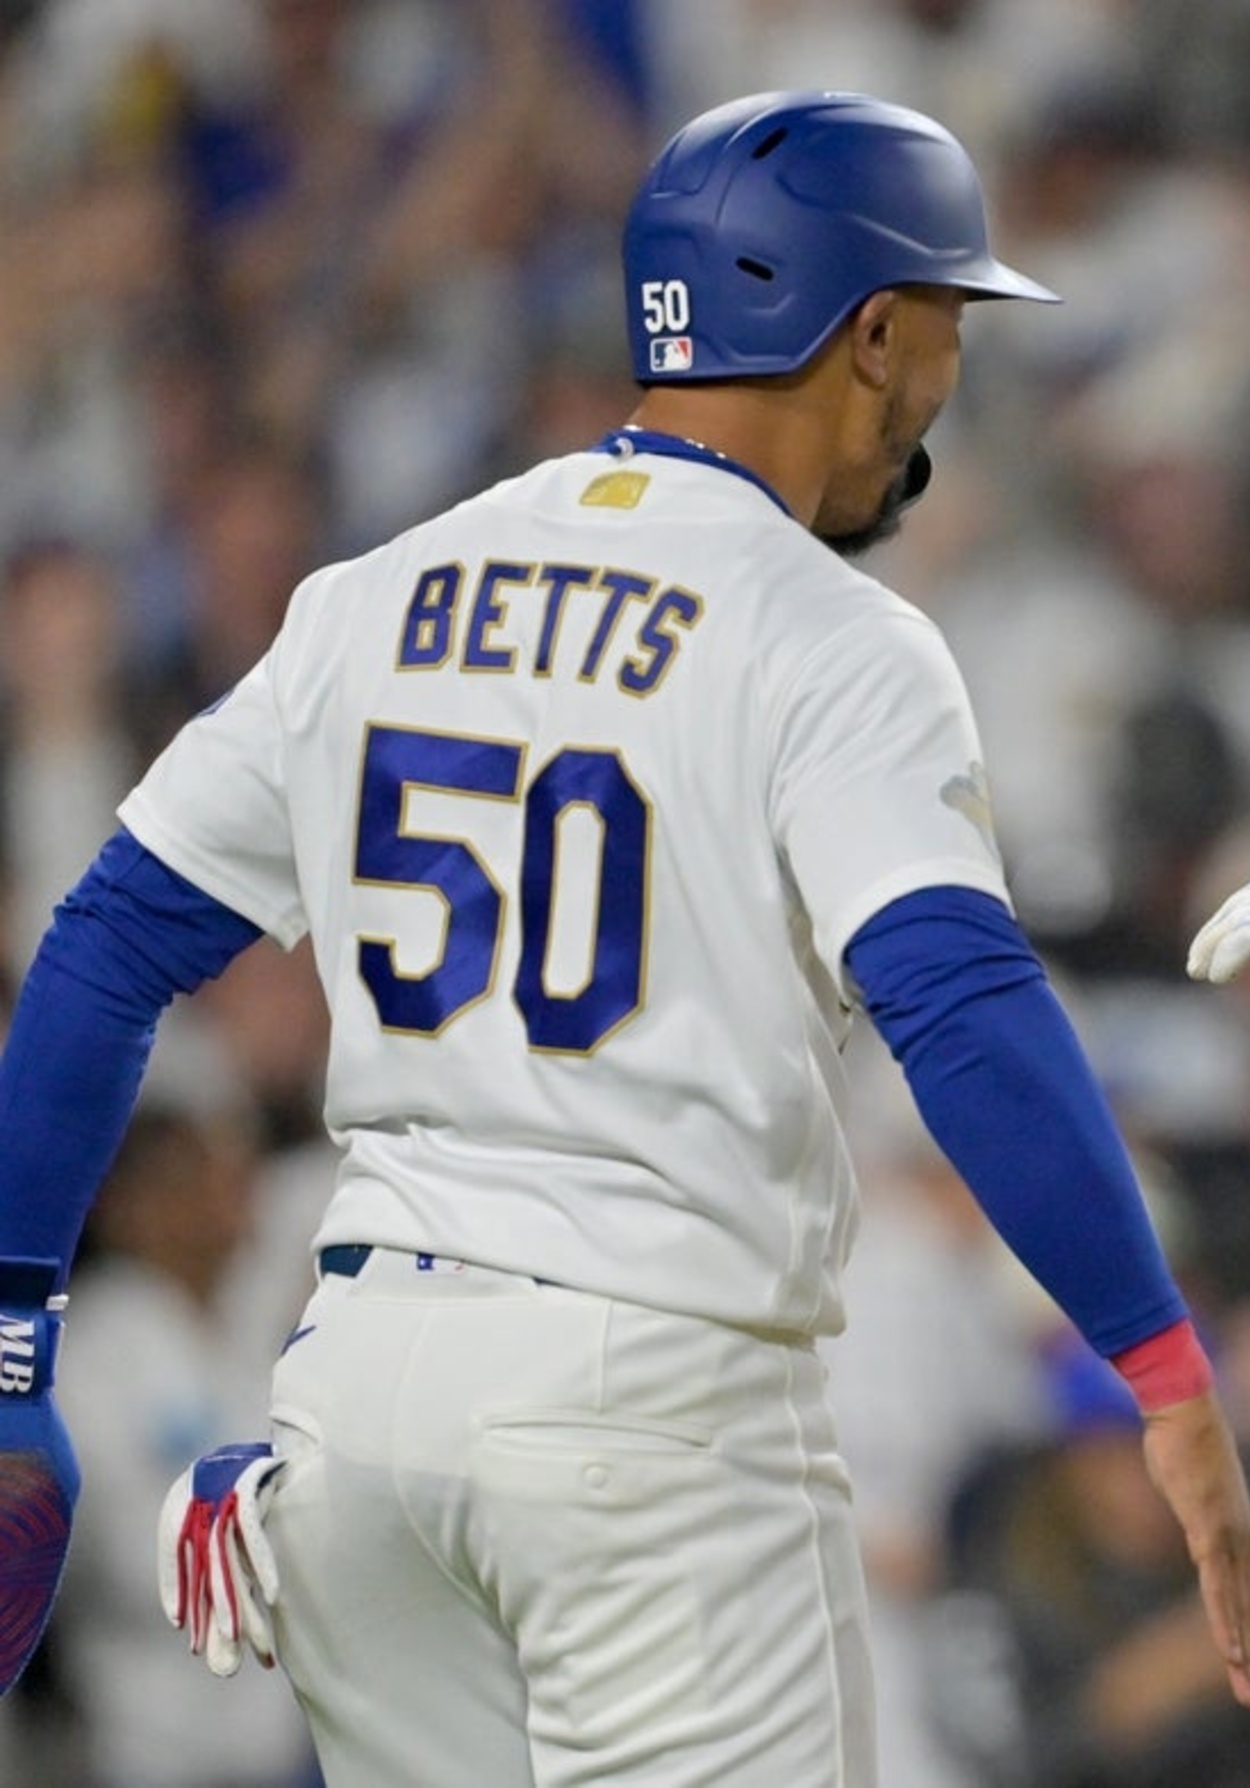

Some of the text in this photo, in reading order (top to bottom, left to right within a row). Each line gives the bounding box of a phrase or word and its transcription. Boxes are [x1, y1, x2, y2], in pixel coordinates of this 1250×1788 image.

[642, 280, 690, 333] 50
[395, 557, 705, 699] BETTS
[352, 719, 653, 1058] 50
[0, 1313, 35, 1393] MB
